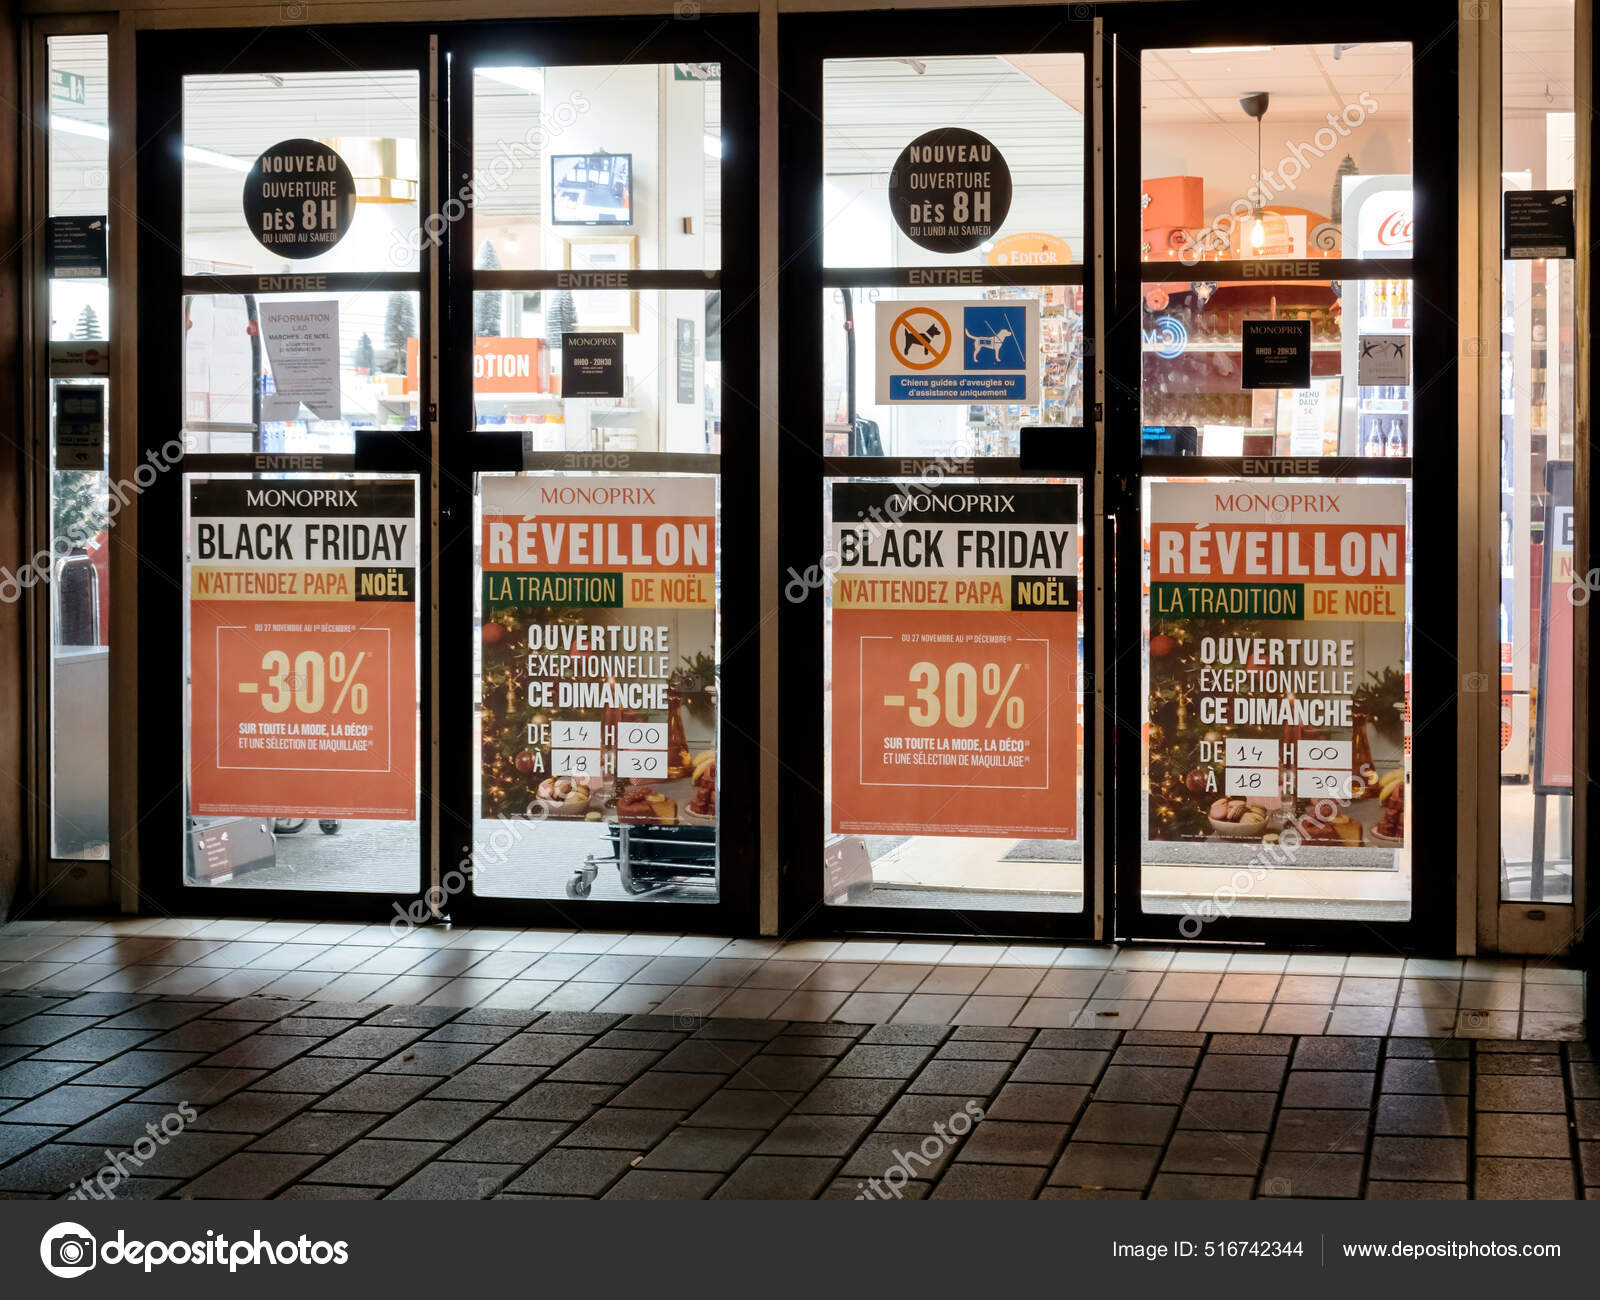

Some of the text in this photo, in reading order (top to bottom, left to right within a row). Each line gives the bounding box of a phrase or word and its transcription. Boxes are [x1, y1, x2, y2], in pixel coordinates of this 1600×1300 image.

[910, 144, 992, 164] NOUVEAU
[262, 155, 337, 173] NOUVEAU
[262, 181, 336, 198] OUVERTURE
[910, 172, 991, 190] OUVERTURE
[263, 199, 337, 231] DÈS 8H
[910, 191, 991, 224] DÈS 8H
[263, 232, 337, 243] DU LUNDI AU SAMEDI
[910, 225, 991, 236] DU LUNDI AU SAMEDI
[909, 269, 983, 284] ENTREE
[1242, 262, 1319, 277] ENTREE
[258, 276, 327, 291] ENTREE
[557, 272, 629, 288] ENTREE
[268, 313, 330, 323] INFORMATION
[1250, 326, 1304, 335] MONOPRIX
[568, 337, 617, 346] MONOPRIX
[901, 379, 929, 387] Chiens
[930, 379, 958, 389] guides
[959, 379, 1003, 389] d'aveugles
[908, 389, 1008, 398] d'assistance uniquement
[255, 456, 324, 470] ENTREE
[901, 459, 975, 474] ENTREE
[1242, 459, 1320, 475] ENTREE
[246, 490, 358, 507] MONOPRIX
[541, 487, 656, 505] MONOPRIX
[893, 494, 1015, 513] MONOPRIX
[1215, 494, 1340, 513] MONOPRIX
[198, 523, 408, 560] BLACK FRIDAY
[489, 514, 708, 566] RÉVEILLON
[840, 529, 1069, 569] BLACK FRIDAY
[1159, 522, 1397, 577] RÉVEILLON
[197, 569, 408, 596] N'ATTENDEZ PAPA NOËL
[489, 574, 708, 603] LA TRADITION DE NOËL
[840, 577, 1069, 606] N'ATTENDEZ PAPA NOËL
[1159, 585, 1396, 615] LA TRADITION DE NOËL
[264, 624, 272, 632] 27
[272, 624, 303, 632] NOVEMBRE
[528, 624, 669, 652] OUVERTURE
[901, 634, 910, 642] DU
[911, 634, 920, 642] 27
[921, 634, 954, 642] NOVEMBRE
[955, 634, 964, 642] AU
[1200, 637, 1354, 667] OUVERTURE
[528, 654, 669, 679] EXEPTIONNELLE
[238, 650, 369, 715] -30%
[1200, 669, 1353, 694] EXEPTIONNELLE
[528, 681, 669, 710] CE DIMANCHE
[884, 661, 1025, 729] -30%
[1200, 697, 1353, 727] CE DIMANCHE
[239, 723, 257, 735] SUR
[258, 723, 286, 735] TOUTE
[288, 724, 300, 736] LA
[301, 724, 329, 738] MODE,
[331, 725, 343, 736] LA
[528, 723, 660, 746] DE 14 H 00
[239, 737, 368, 752] ET UNE SÉLECTION DE MAQUILLAGE
[884, 737, 903, 749] SUR
[905, 738, 935, 750] TOUTE
[937, 738, 950, 750] LA
[952, 738, 982, 752] MODE,
[985, 739, 997, 751] LA
[1200, 740, 1339, 764] DE 14 H 00
[533, 747, 658, 775] À 18 H 30
[883, 751, 1024, 768] ET UNE SÉLECTION DE MAQUILLAGE
[1205, 766, 1338, 795] À 18 H 30
